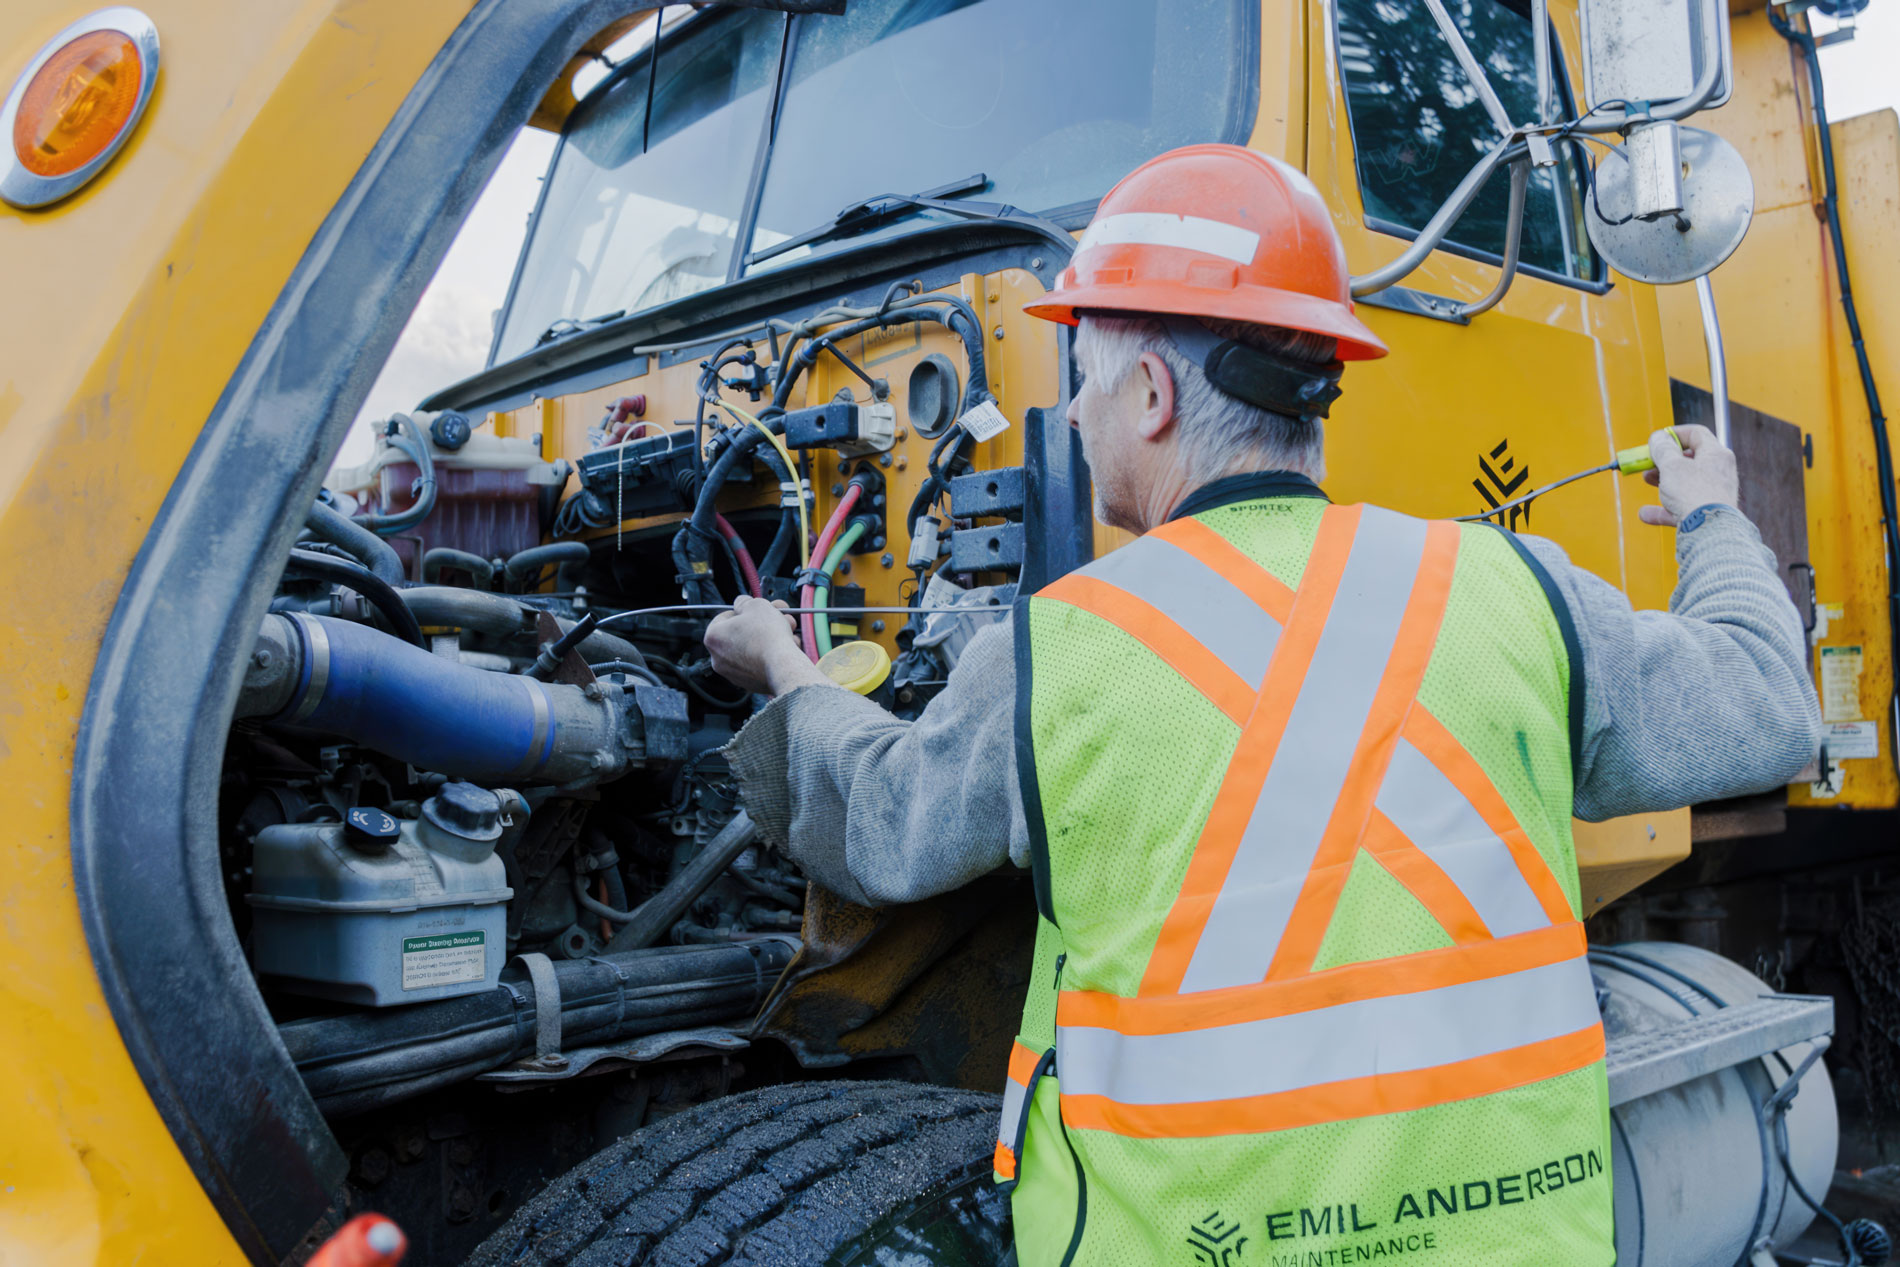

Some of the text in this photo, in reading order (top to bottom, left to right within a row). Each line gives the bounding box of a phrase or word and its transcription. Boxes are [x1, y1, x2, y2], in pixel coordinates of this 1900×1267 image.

[1266, 1146, 1602, 1241] EMIL ANDERSON
[1272, 1232, 1437, 1267] MAINTENANCE
